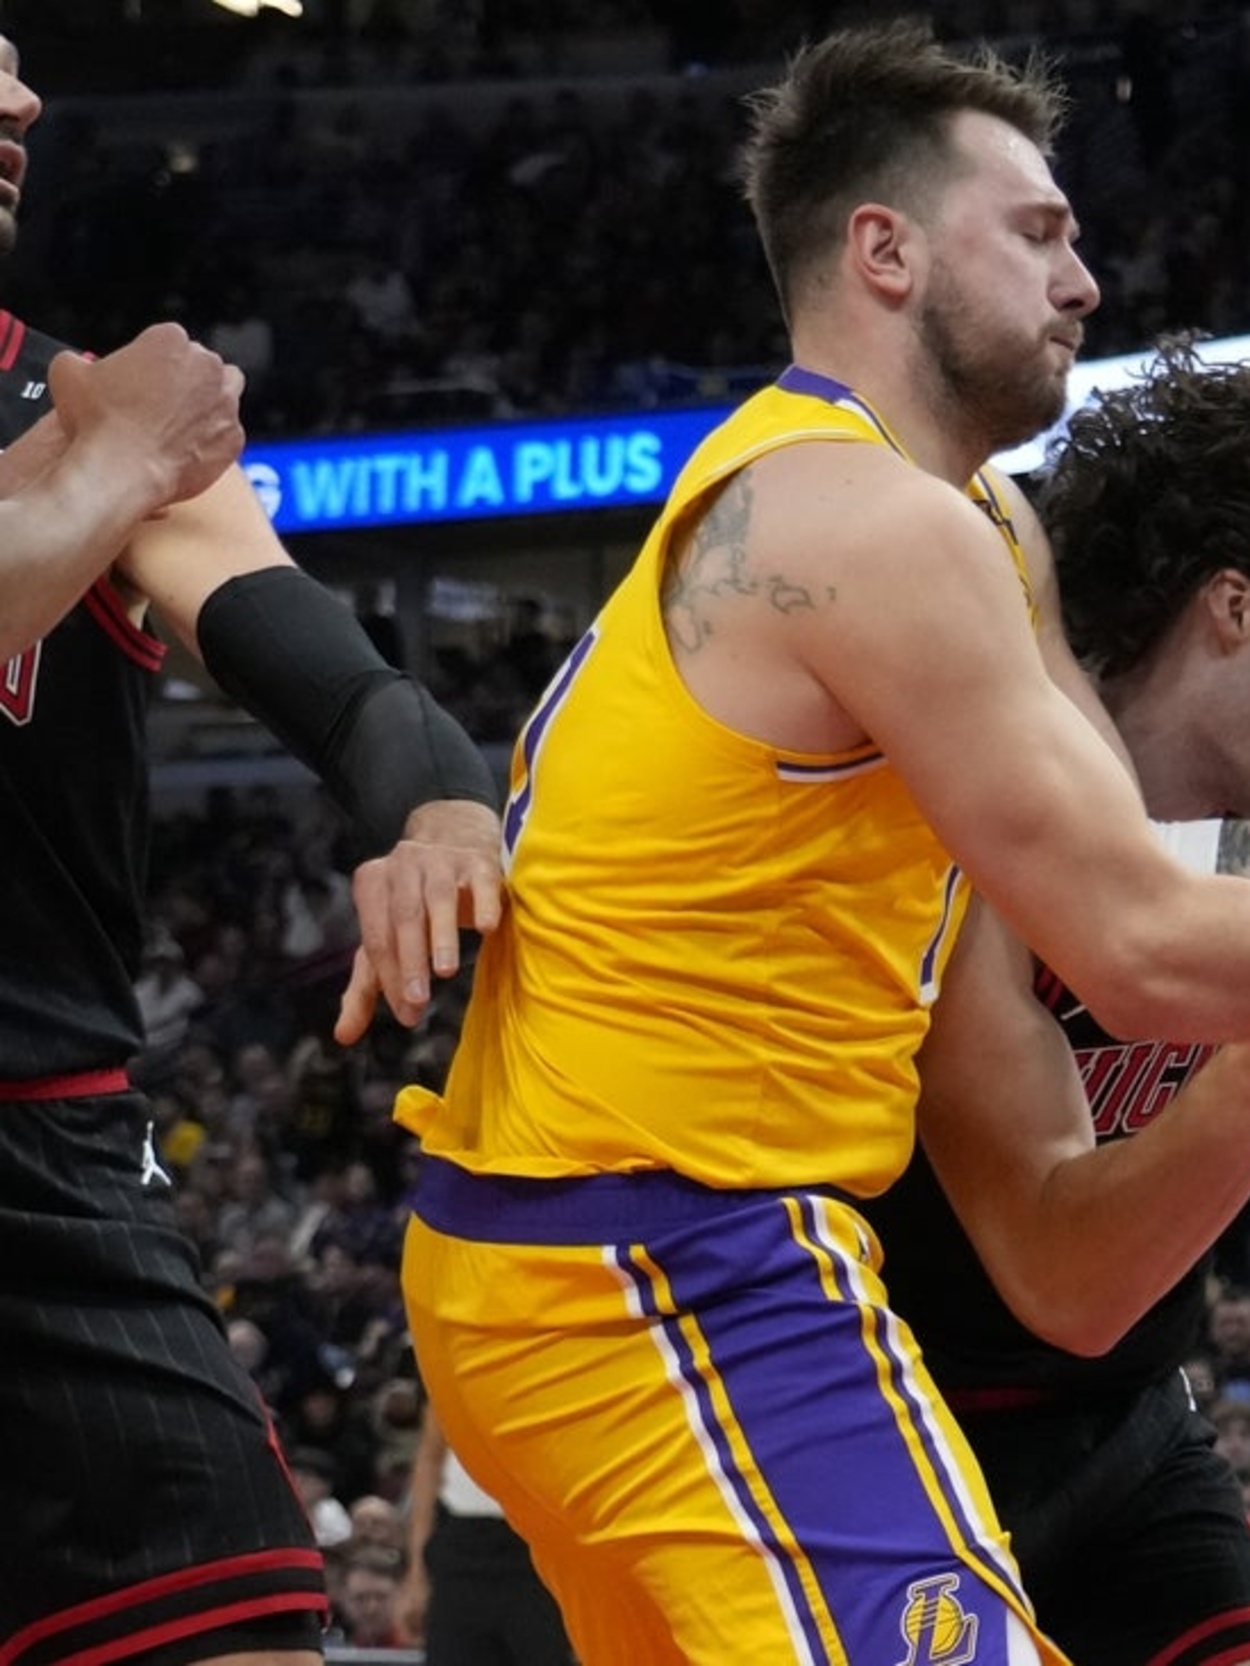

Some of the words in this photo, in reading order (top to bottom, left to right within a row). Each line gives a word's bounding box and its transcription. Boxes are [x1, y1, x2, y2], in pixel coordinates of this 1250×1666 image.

[292, 450, 449, 520] WITH
[456, 446, 506, 508] A
[513, 430, 662, 503] PLUS
